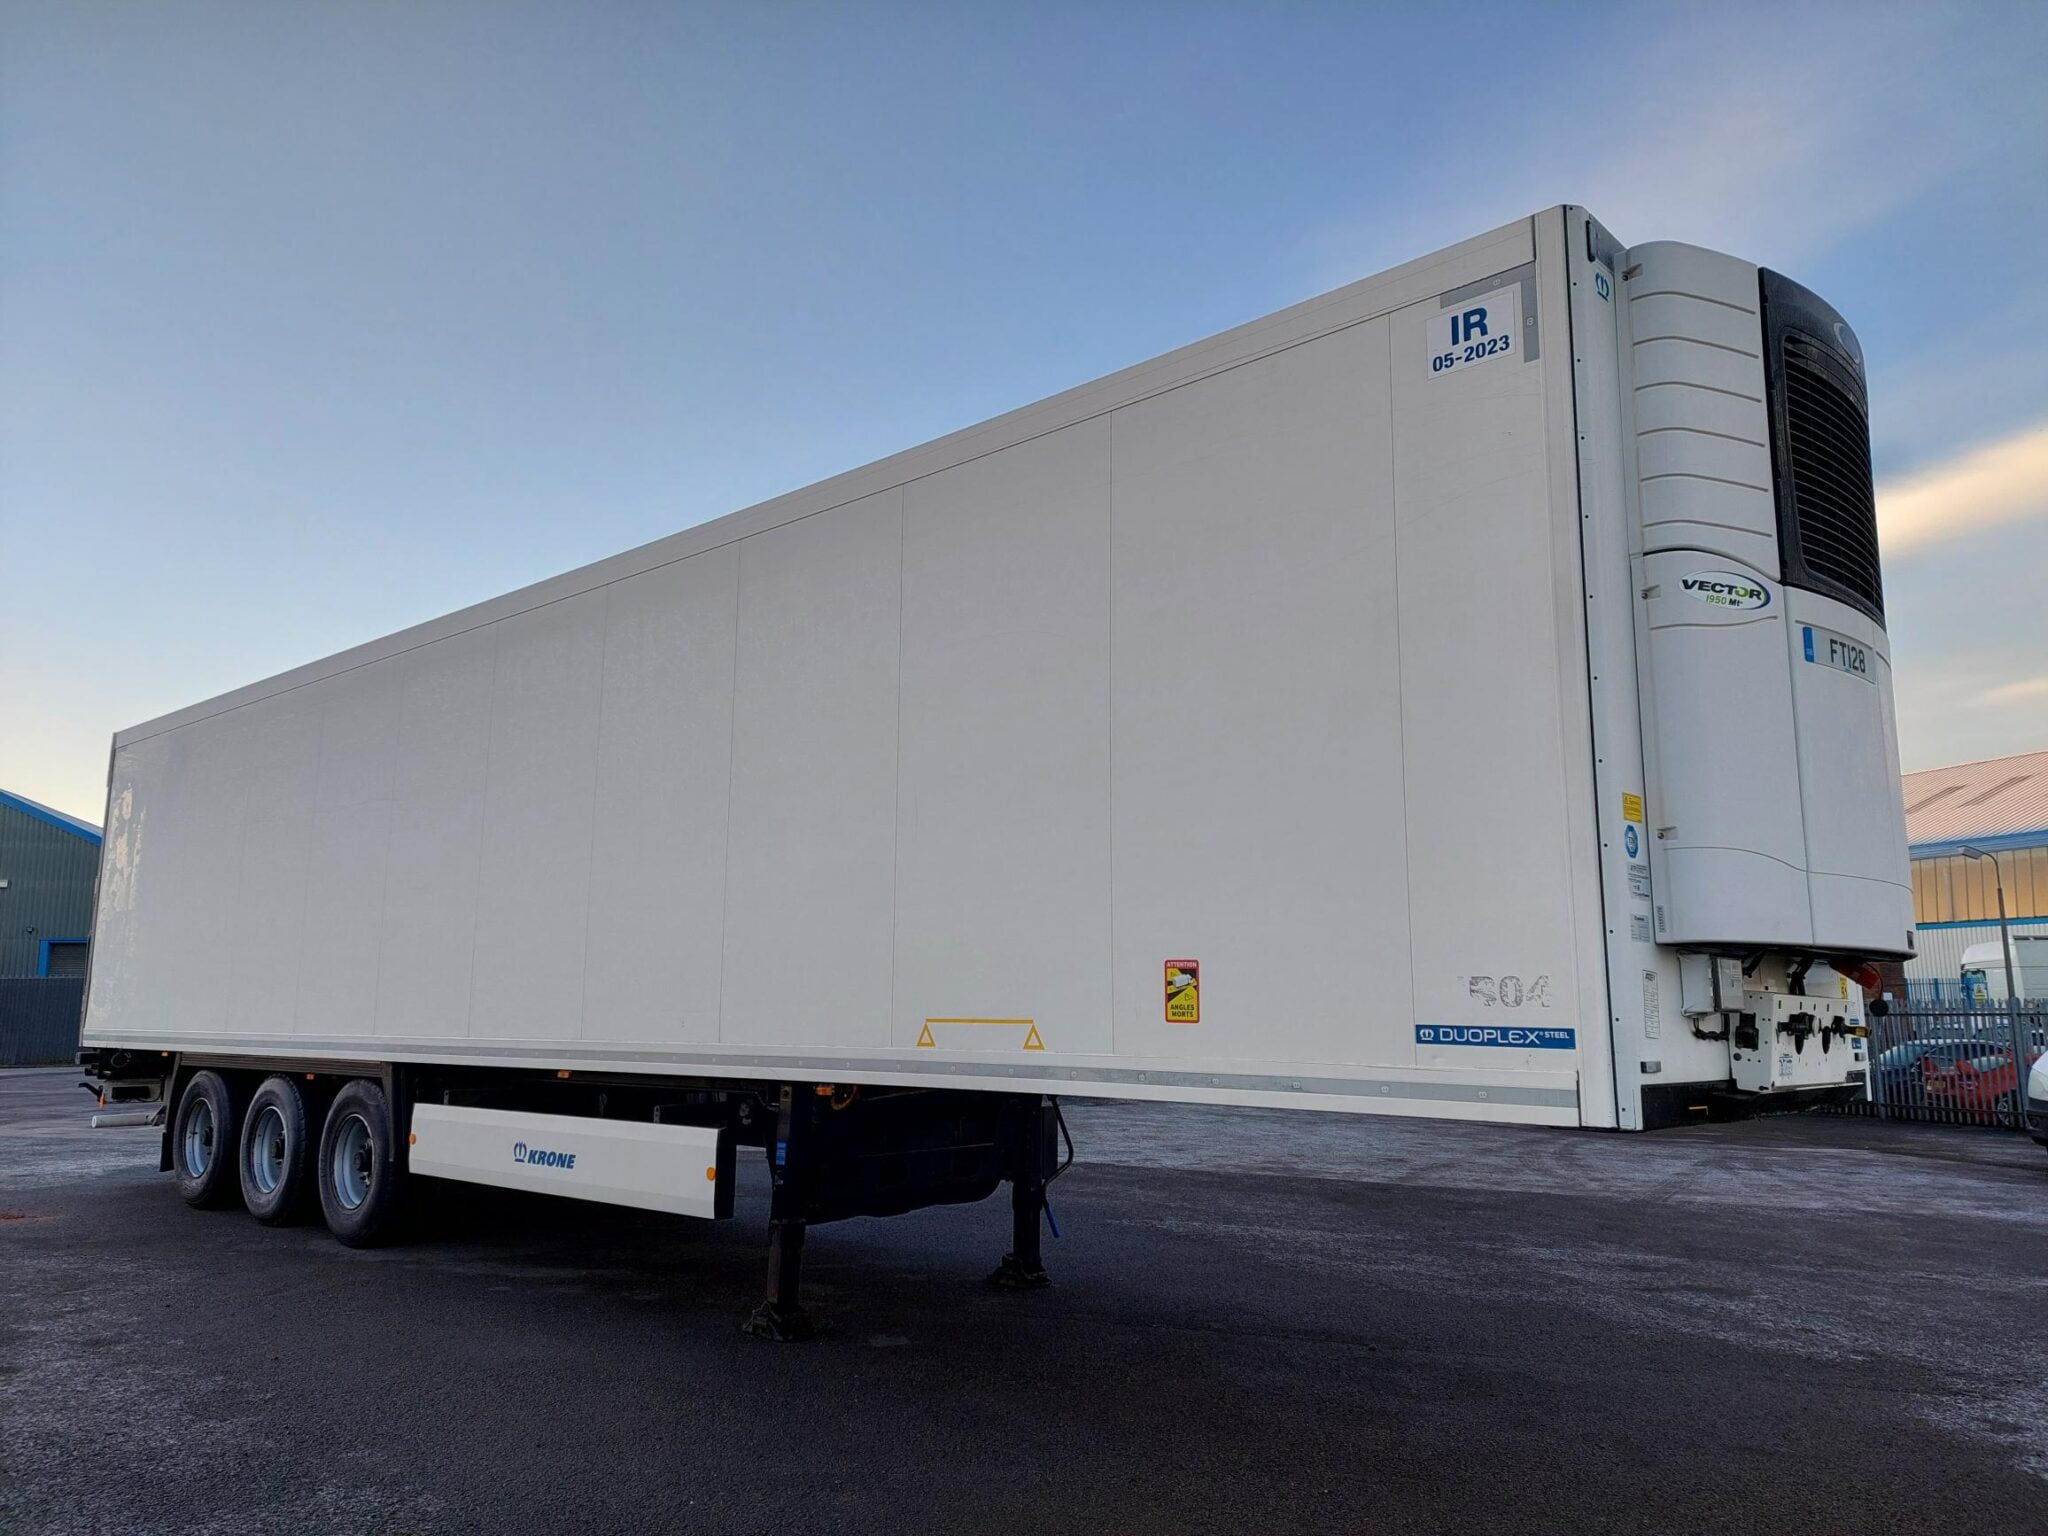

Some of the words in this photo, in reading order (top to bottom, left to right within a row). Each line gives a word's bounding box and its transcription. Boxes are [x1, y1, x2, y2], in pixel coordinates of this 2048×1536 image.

[1451, 307, 1488, 346] IR
[1432, 334, 1510, 372] 05-2023
[1681, 579, 1762, 601] VECTOR
[1705, 594, 1727, 605] 1950
[1829, 638, 1866, 674] FT128
[1170, 1003, 1195, 1011] ANGLES
[1171, 1010, 1194, 1018] MORTS
[1544, 1030, 1570, 1039] STEEL
[527, 1149, 577, 1169] KRONE
